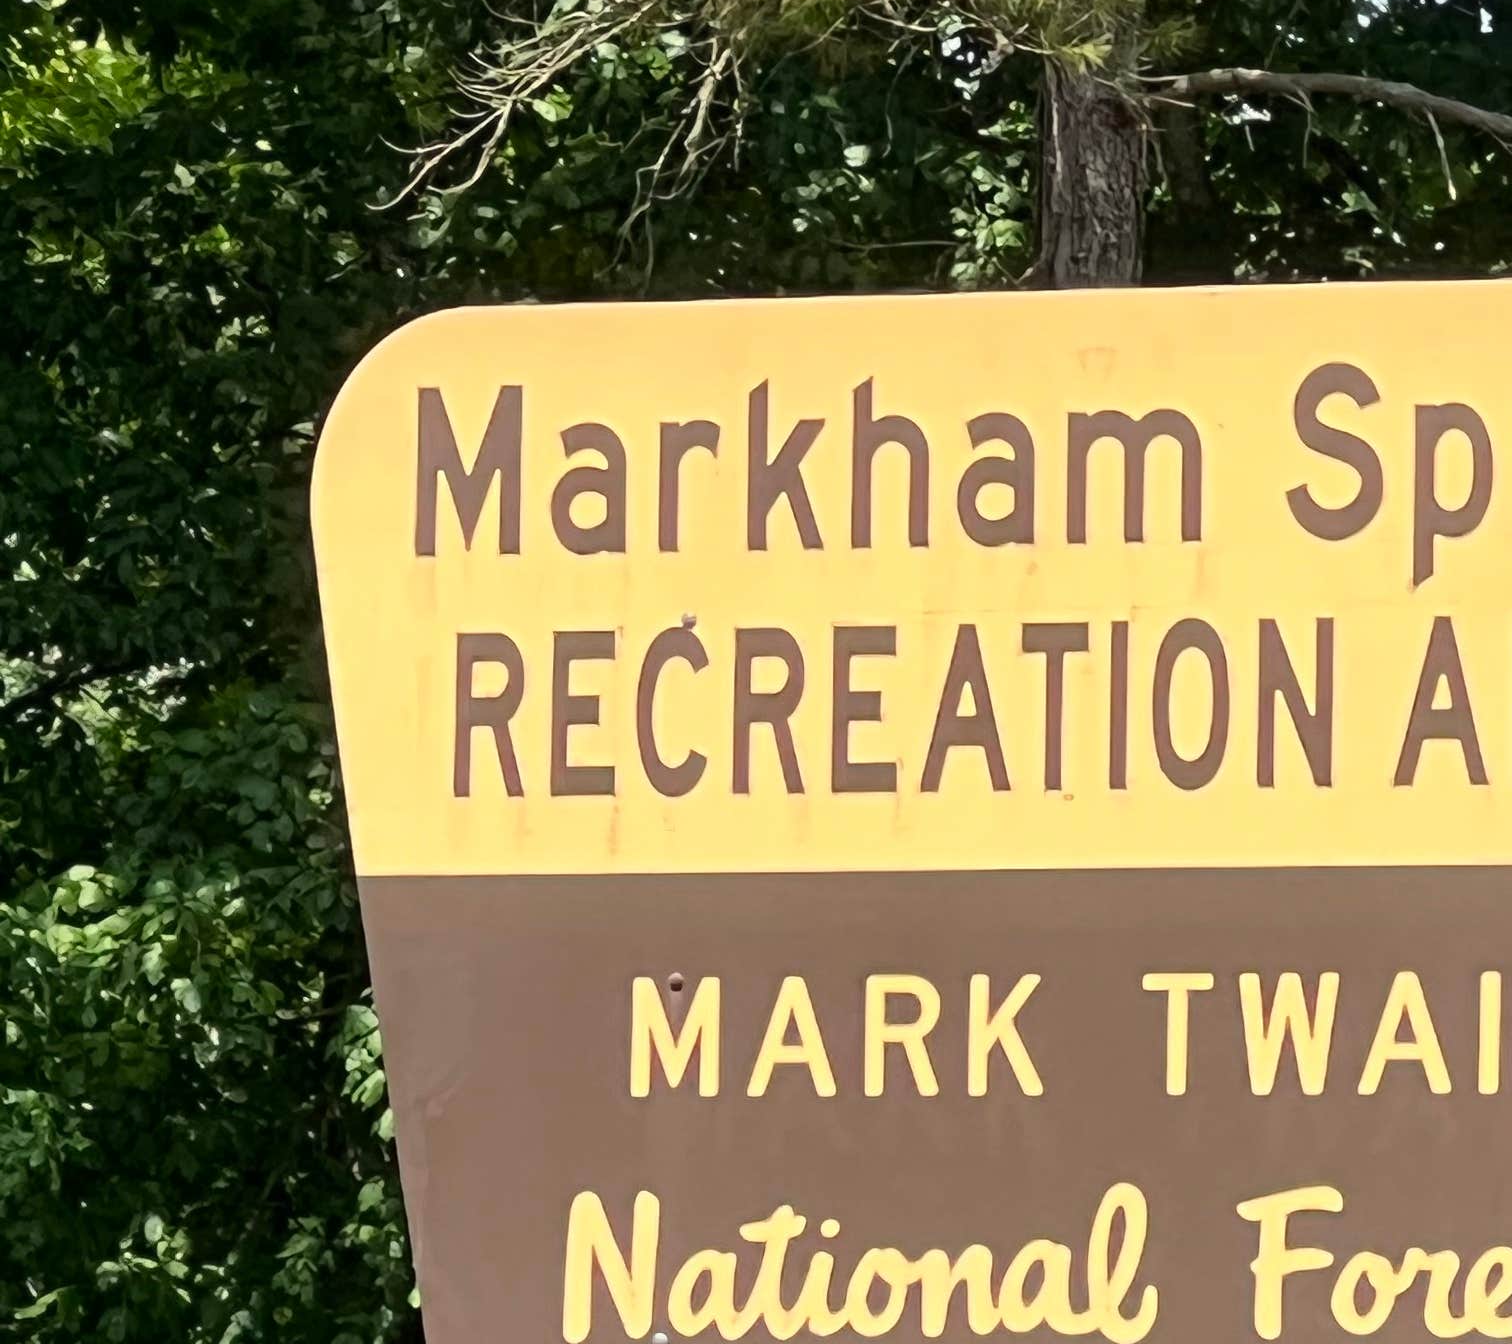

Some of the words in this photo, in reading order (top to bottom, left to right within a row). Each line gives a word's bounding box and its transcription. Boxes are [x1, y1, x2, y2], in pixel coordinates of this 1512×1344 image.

[414, 376, 1203, 558] Markham
[452, 617, 1335, 798] RECREATION
[630, 973, 1044, 1098] MARK
[562, 1182, 1159, 1344] National
